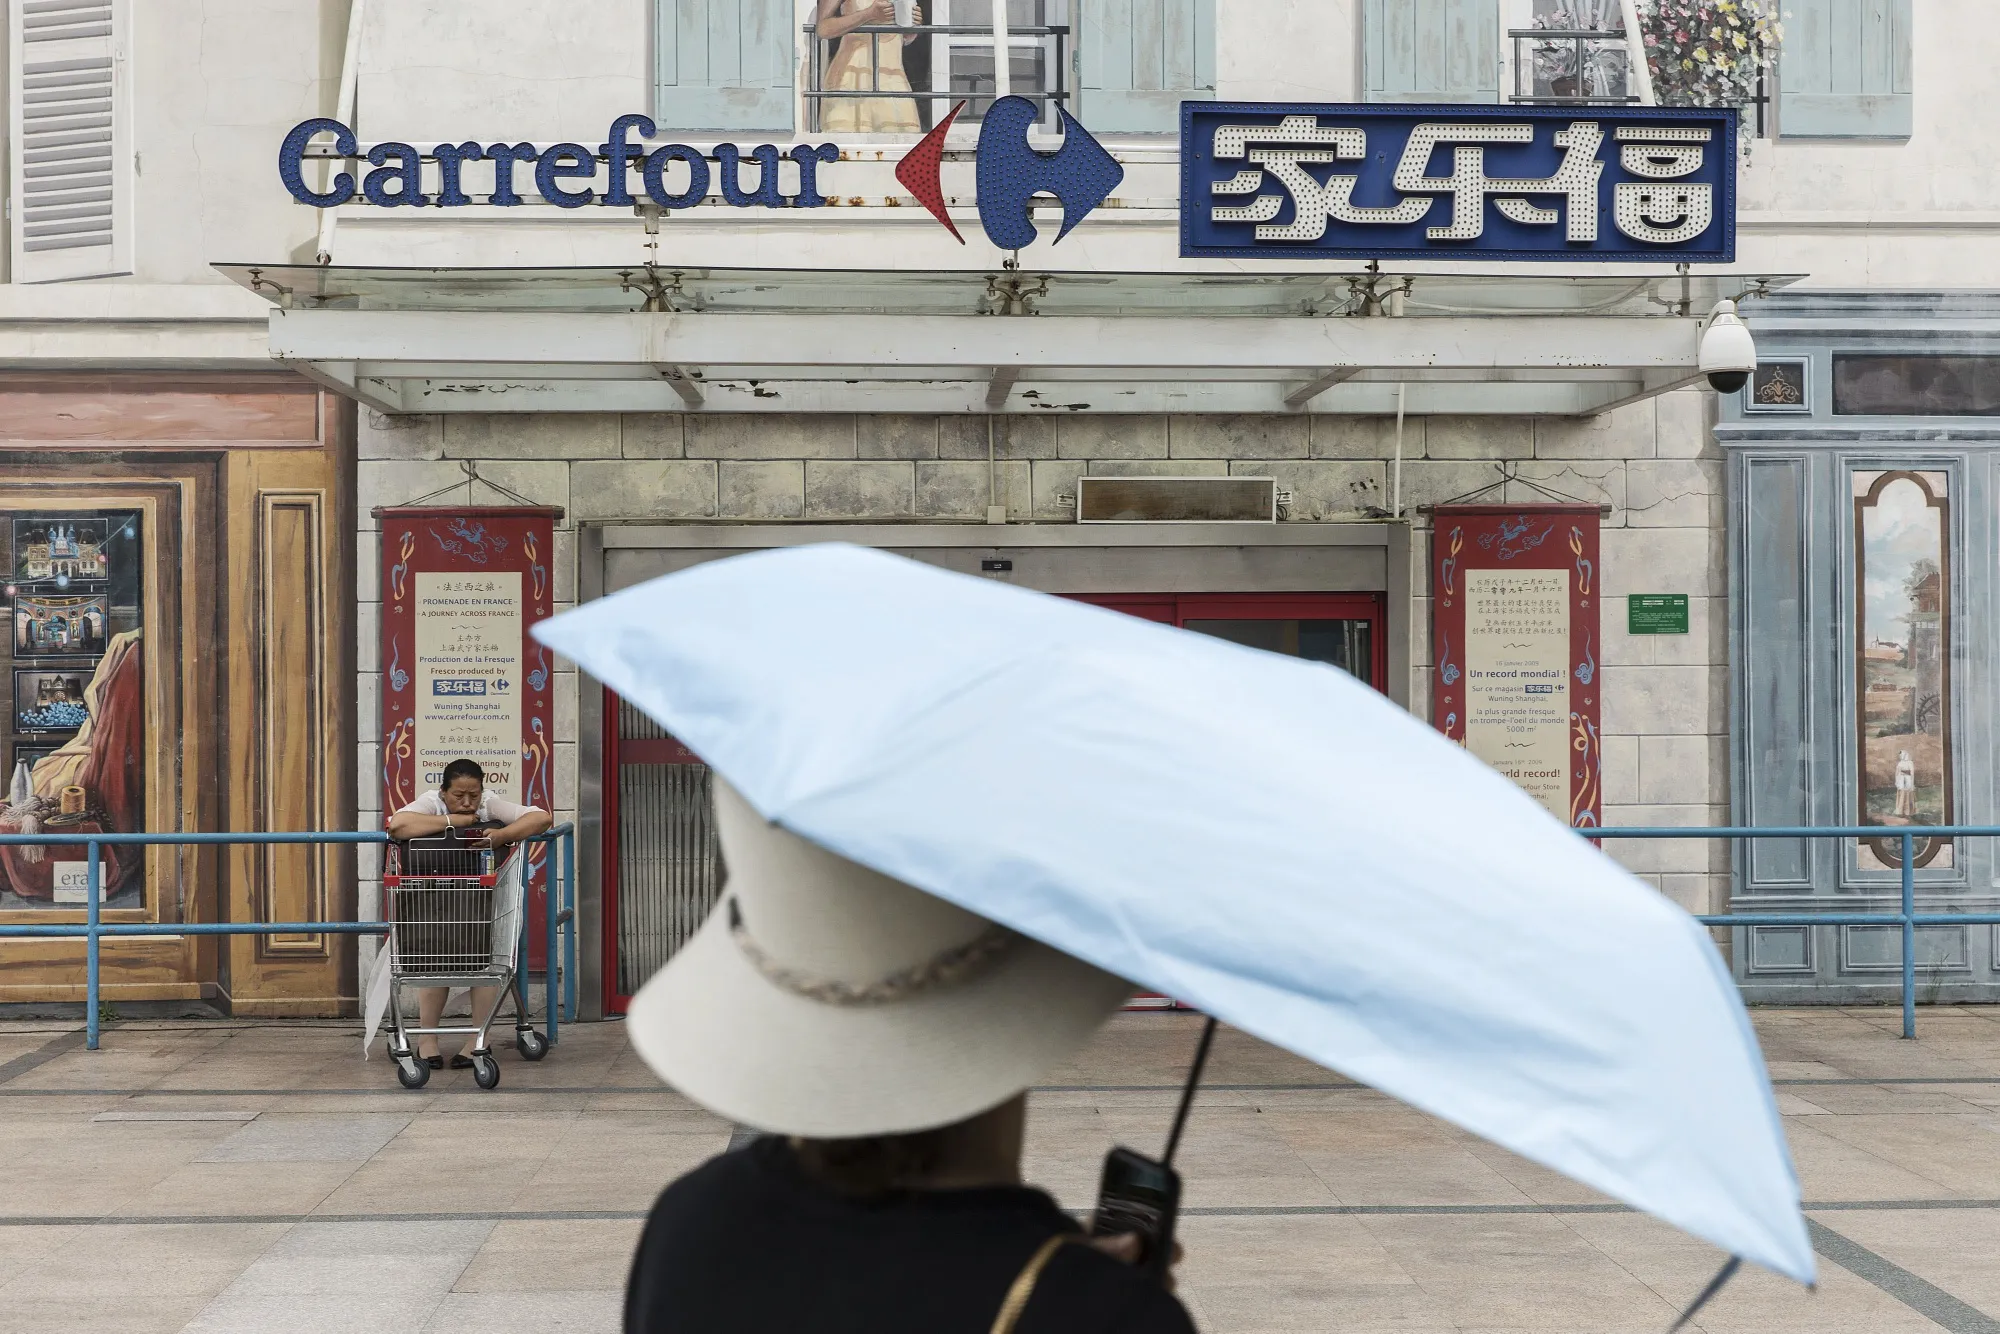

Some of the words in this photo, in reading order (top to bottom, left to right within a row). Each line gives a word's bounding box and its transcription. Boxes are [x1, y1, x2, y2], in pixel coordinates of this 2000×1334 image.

[279, 114, 839, 209] Carrefour
[1211, 115, 1713, 243] 家乐福
[443, 582, 495, 591] 法兰西之旅
[484, 656, 515, 664] Fresque
[458, 667, 494, 675] produced
[496, 667, 506, 676] by
[1469, 670, 1483, 678] Un
[1486, 669, 1517, 678] record
[1520, 669, 1560, 678] mondial
[436, 681, 485, 693] 家乐福
[1488, 695, 1514, 703] Wuning
[433, 703, 463, 711] Wuning
[465, 703, 501, 711] Shanghai
[1484, 708, 1499, 716] plus
[1501, 708, 1527, 716] grande
[1529, 708, 1556, 716] fresque
[419, 748, 464, 756] Conception
[422, 760, 448, 768] Design
[502, 760, 512, 768] by
[1523, 769, 1561, 778] record!
